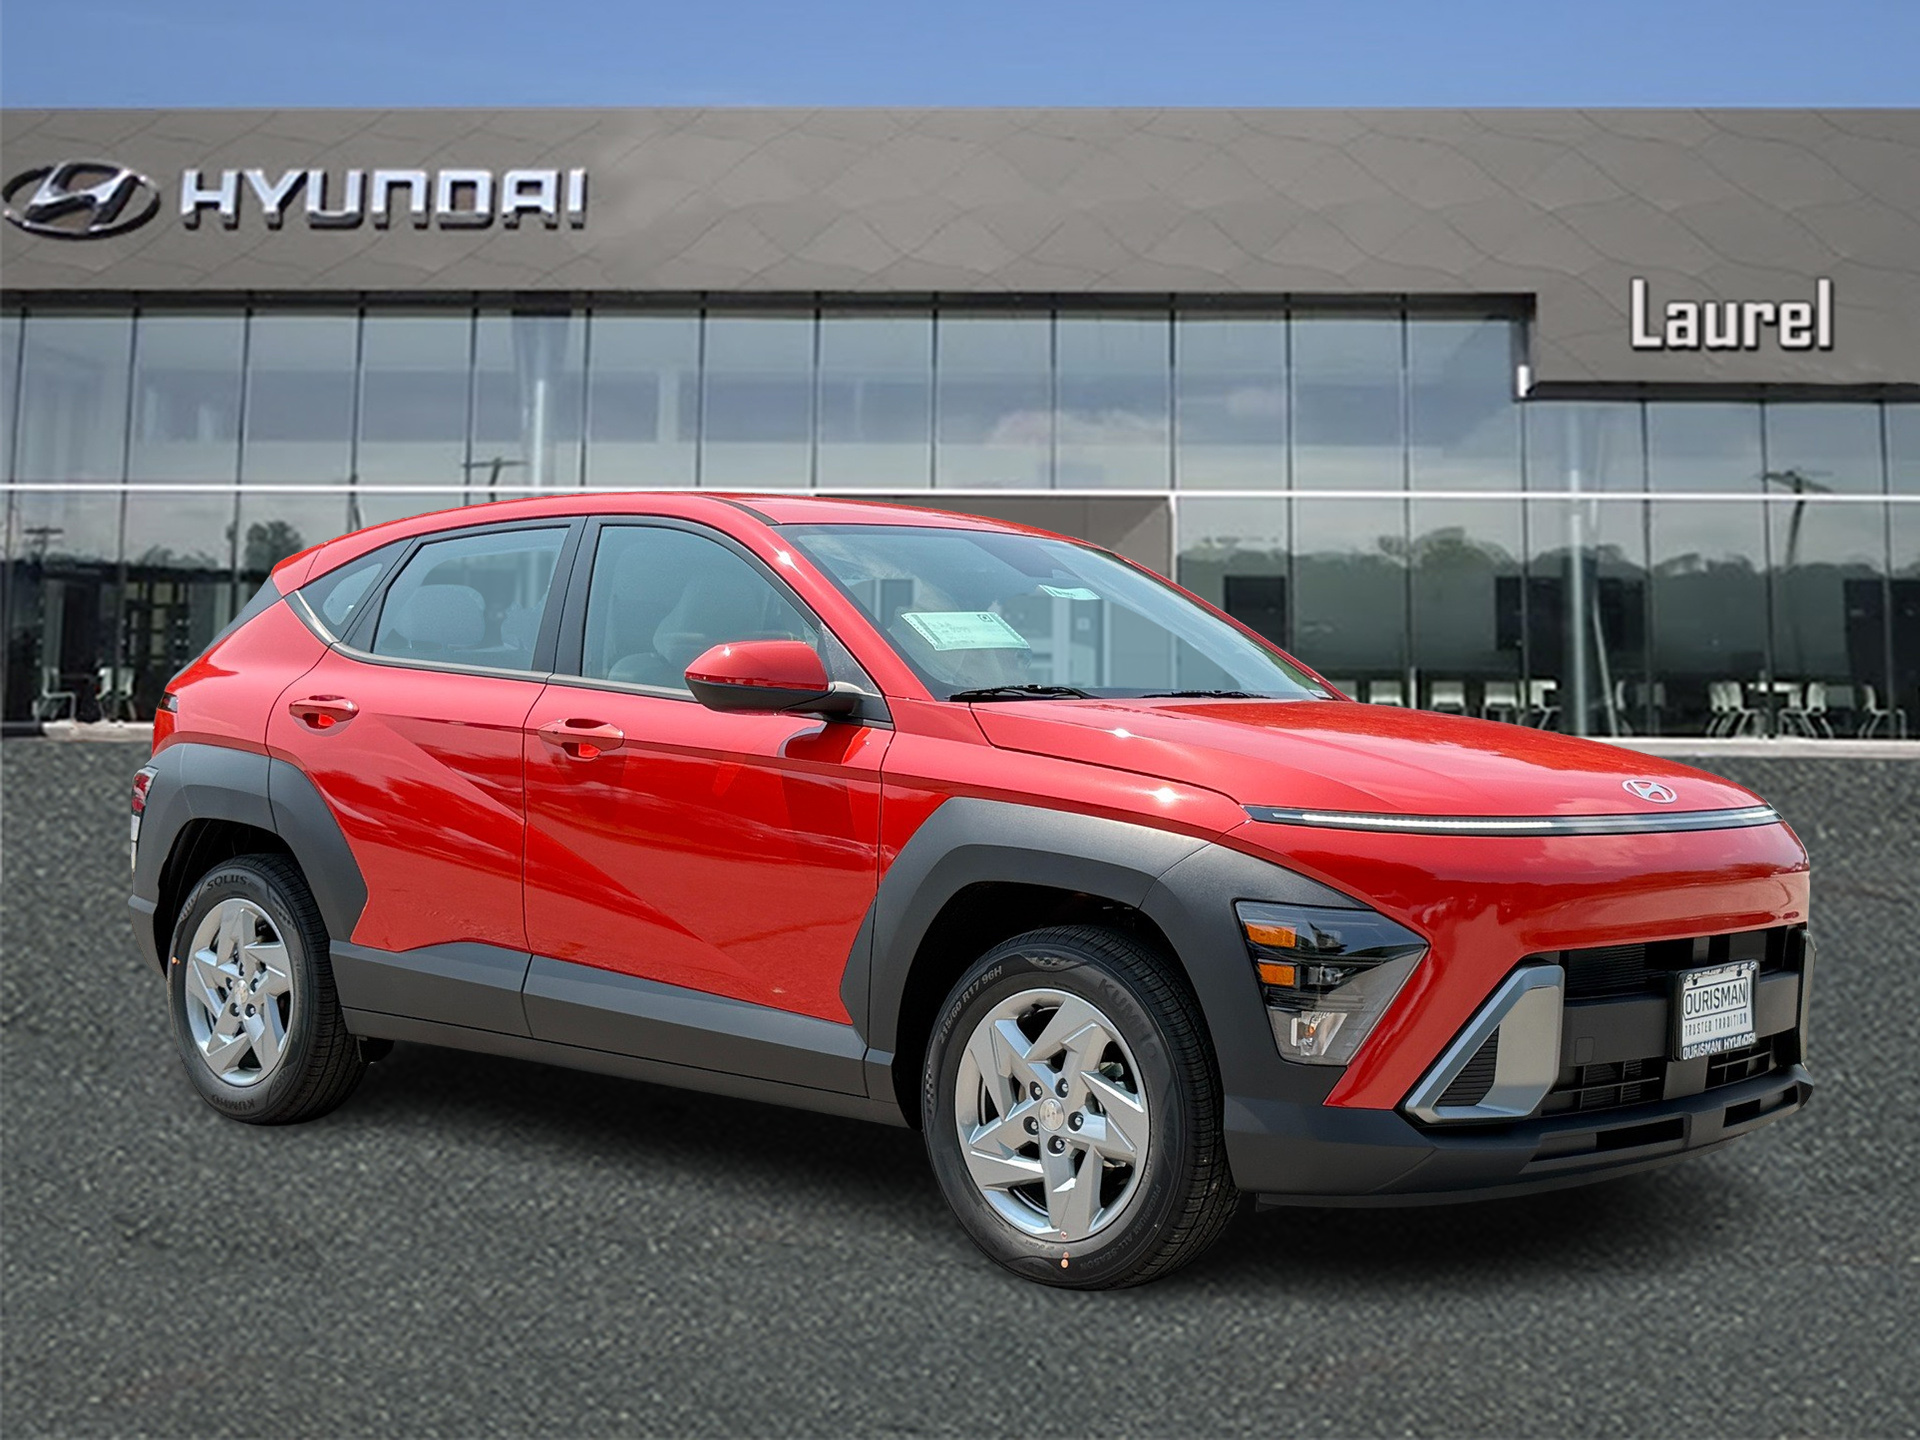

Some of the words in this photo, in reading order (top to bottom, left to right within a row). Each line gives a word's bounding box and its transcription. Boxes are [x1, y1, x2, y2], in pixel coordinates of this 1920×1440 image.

[180, 168, 587, 230] HYUNDAI
[1631, 278, 1833, 348] Laurel
[206, 874, 248, 891] SOLUS
[962, 980, 980, 1003] R17
[981, 965, 1003, 984] 96H
[1685, 982, 1746, 1016] OURISMAN
[1685, 1020, 1712, 1037] TRUSTED
[1715, 1012, 1747, 1031] TRADITION
[1682, 1039, 1721, 1060] OURISMAN
